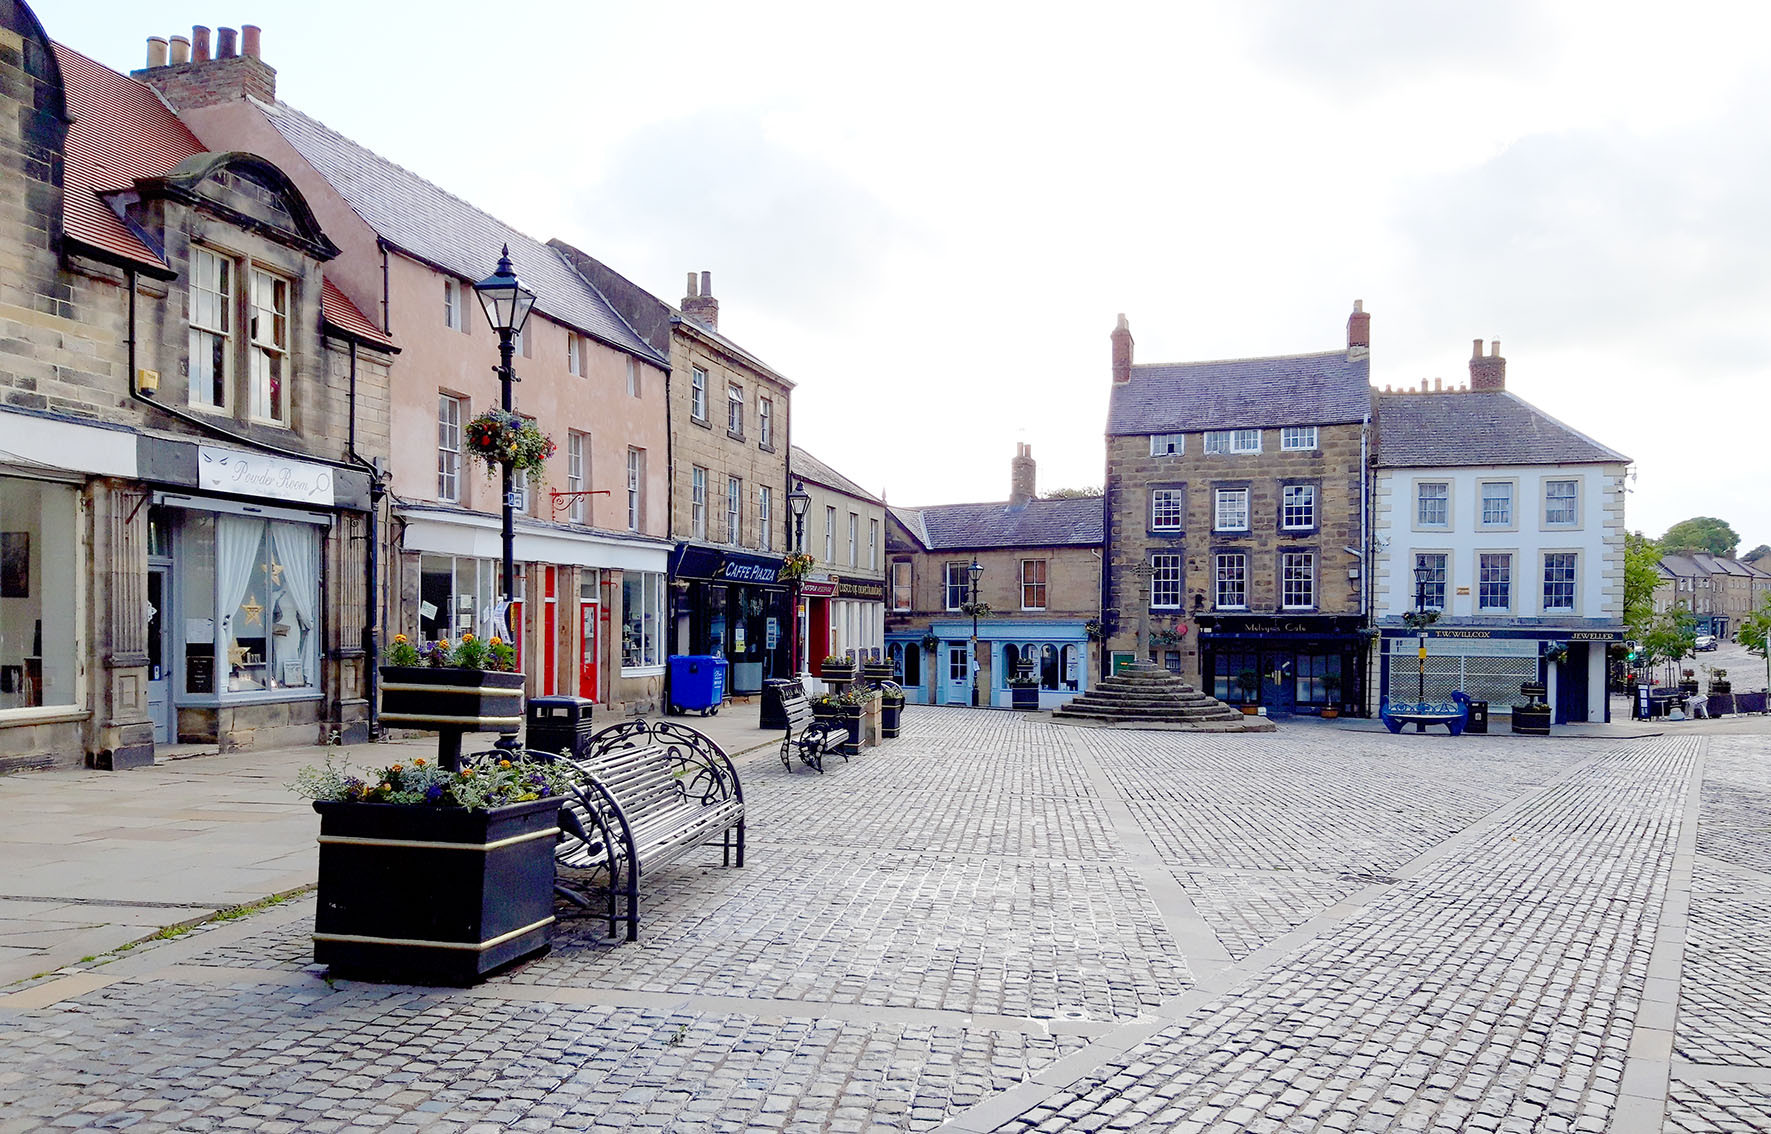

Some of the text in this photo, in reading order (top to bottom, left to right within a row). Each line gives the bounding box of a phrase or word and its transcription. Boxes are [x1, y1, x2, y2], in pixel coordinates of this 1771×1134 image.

[231, 460, 310, 491] Powder Room
[725, 561, 776, 582] CAFFE PIAZZA
[1284, 622, 1307, 633] Cafe
[1571, 632, 1614, 641] JEWELLER
